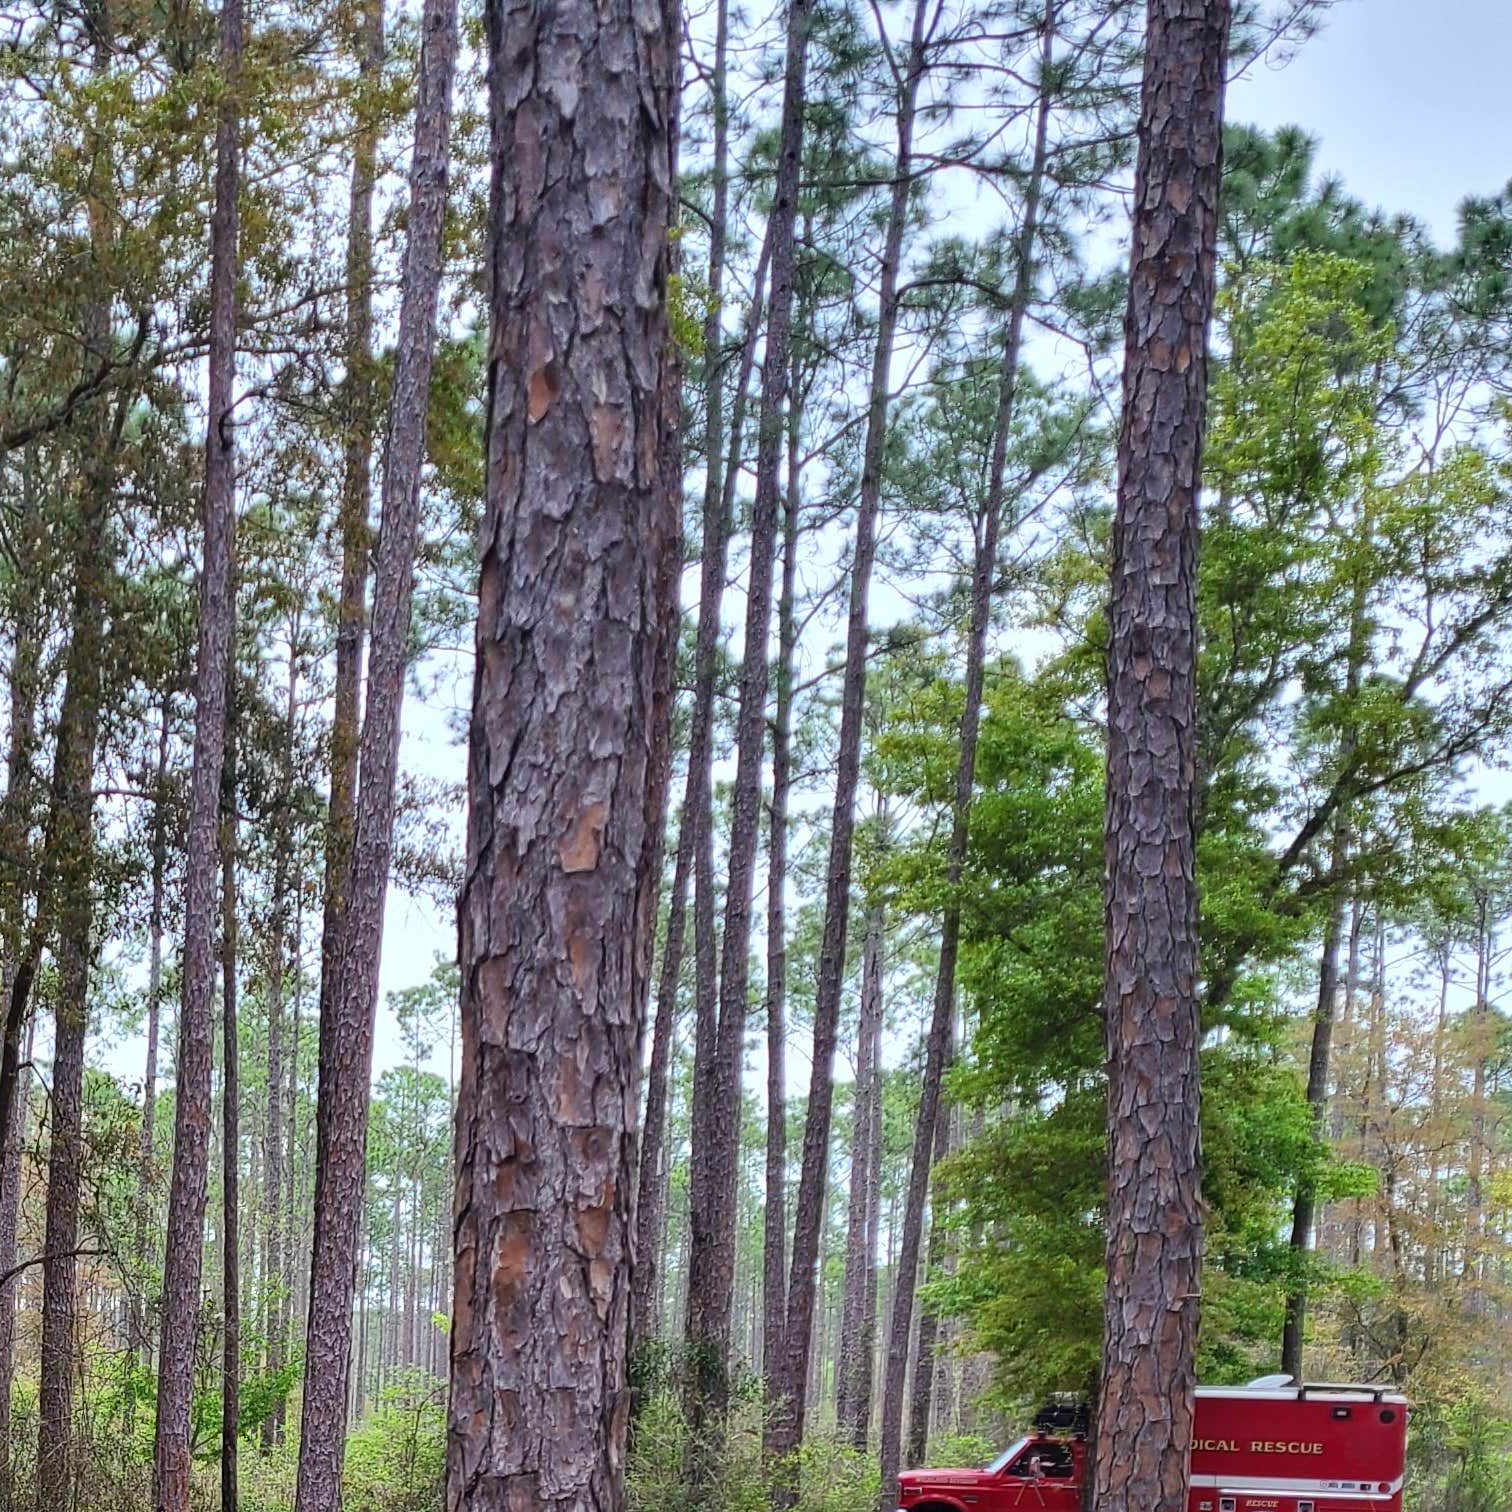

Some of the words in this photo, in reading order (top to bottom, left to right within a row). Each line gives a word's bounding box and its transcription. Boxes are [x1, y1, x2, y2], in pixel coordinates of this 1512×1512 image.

[1190, 1439, 1240, 1452] DICAL
[1250, 1441, 1324, 1455] RESCUE
[1245, 1499, 1279, 1508] RESCUE
